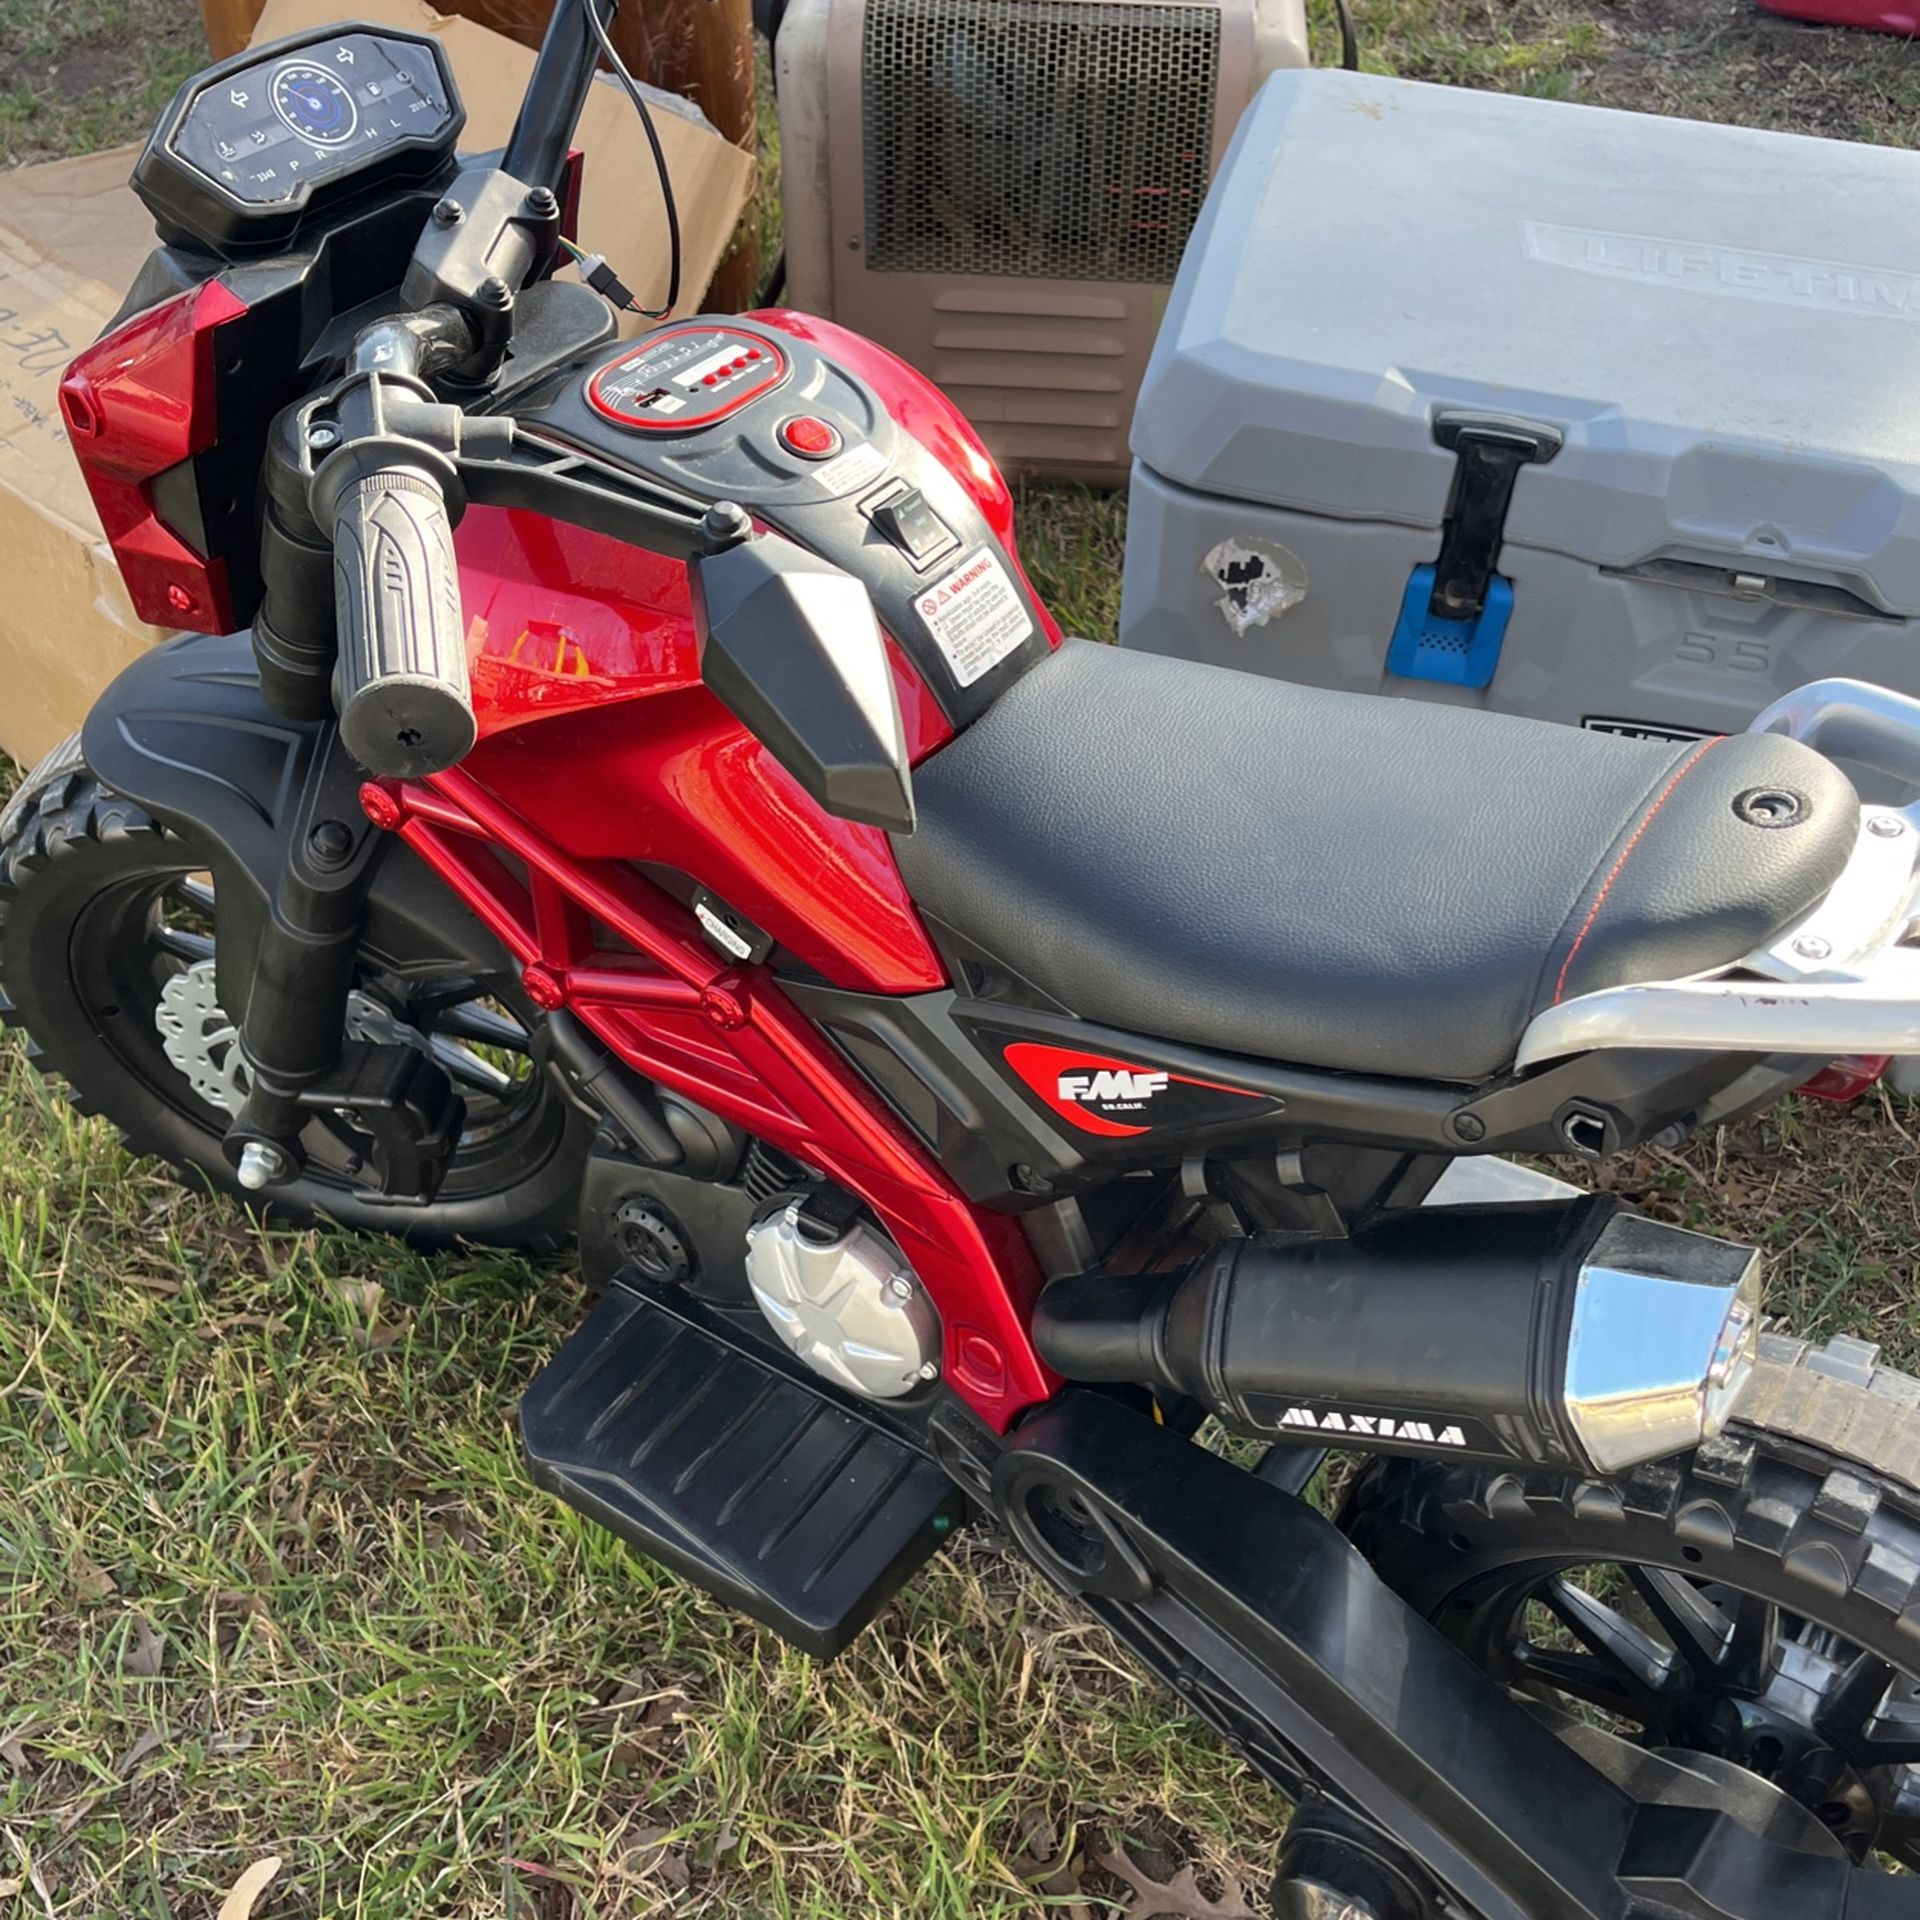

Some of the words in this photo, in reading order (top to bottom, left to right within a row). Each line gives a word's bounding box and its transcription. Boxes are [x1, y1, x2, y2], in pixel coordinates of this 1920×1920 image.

[289, 160, 299, 171] P
[314, 149, 327, 160] R
[365, 128, 378, 139] H
[390, 119, 402, 128] L
[949, 558, 992, 594] WARNING
[1057, 1070, 1168, 1100] FMF
[1280, 1408, 1467, 1446] MAXIMA
